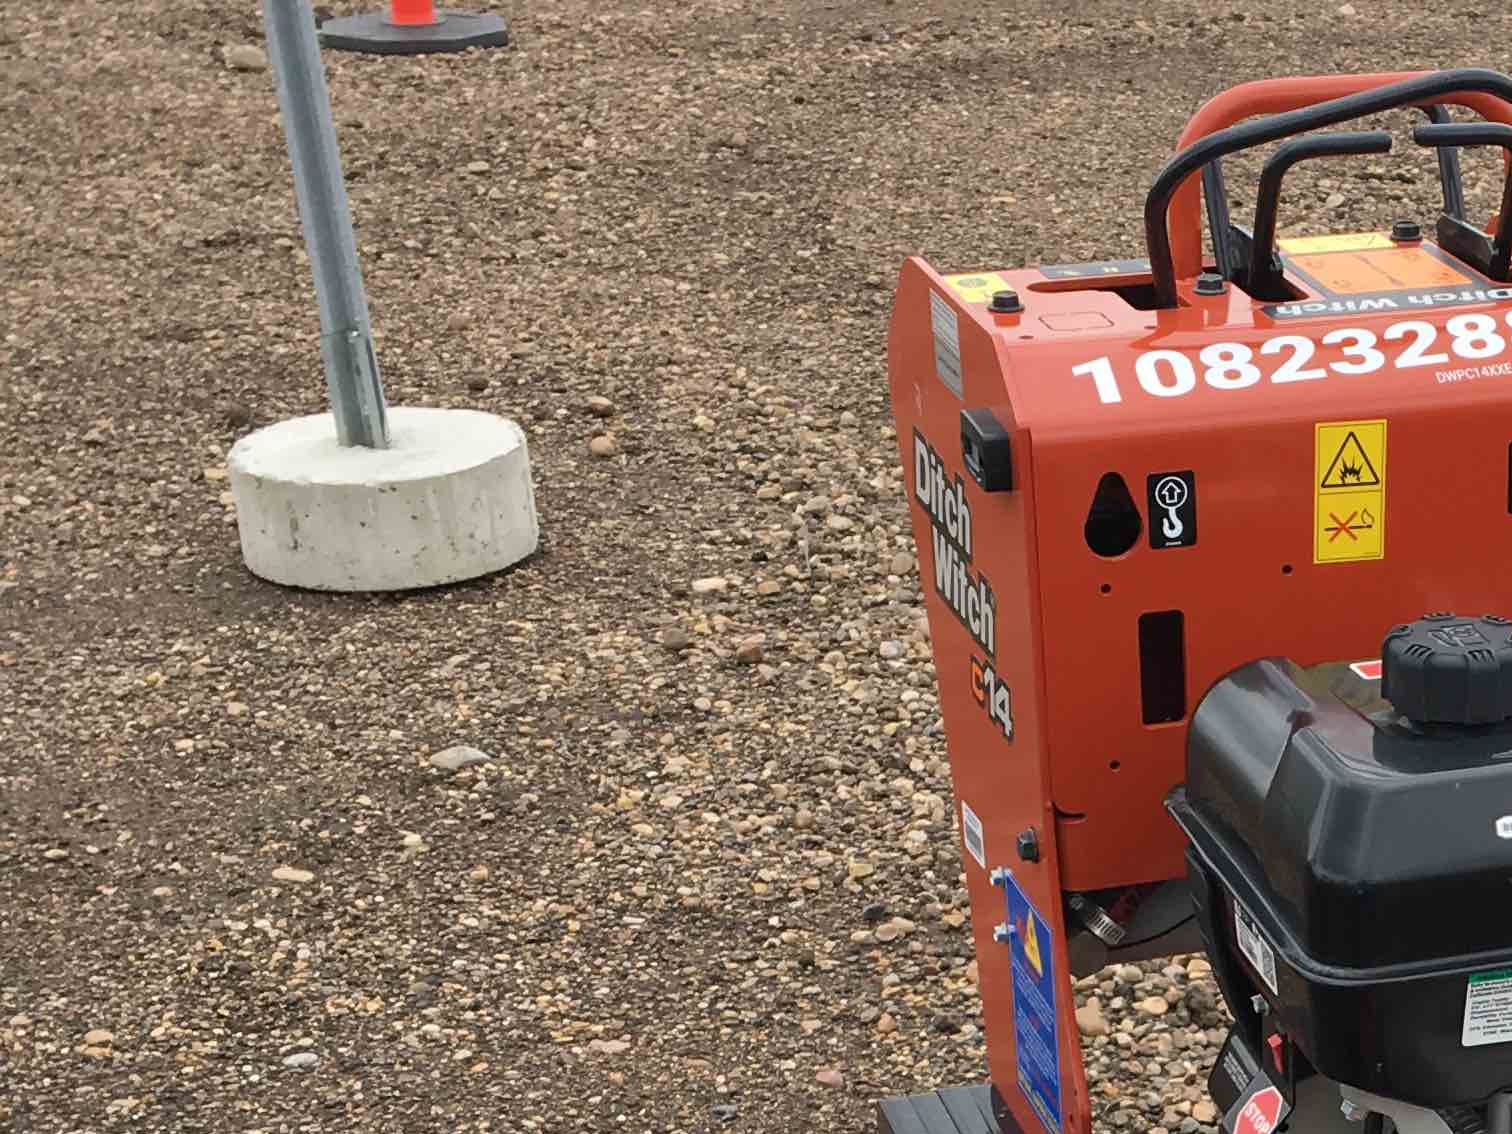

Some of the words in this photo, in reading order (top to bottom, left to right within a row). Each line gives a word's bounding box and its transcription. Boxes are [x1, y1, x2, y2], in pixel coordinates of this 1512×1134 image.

[1275, 297, 1398, 317] Witch
[913, 435, 971, 556] Ditch
[931, 525, 995, 656] Witch
[971, 659, 1013, 737] C14
[1245, 1102, 1270, 1134] STOP
